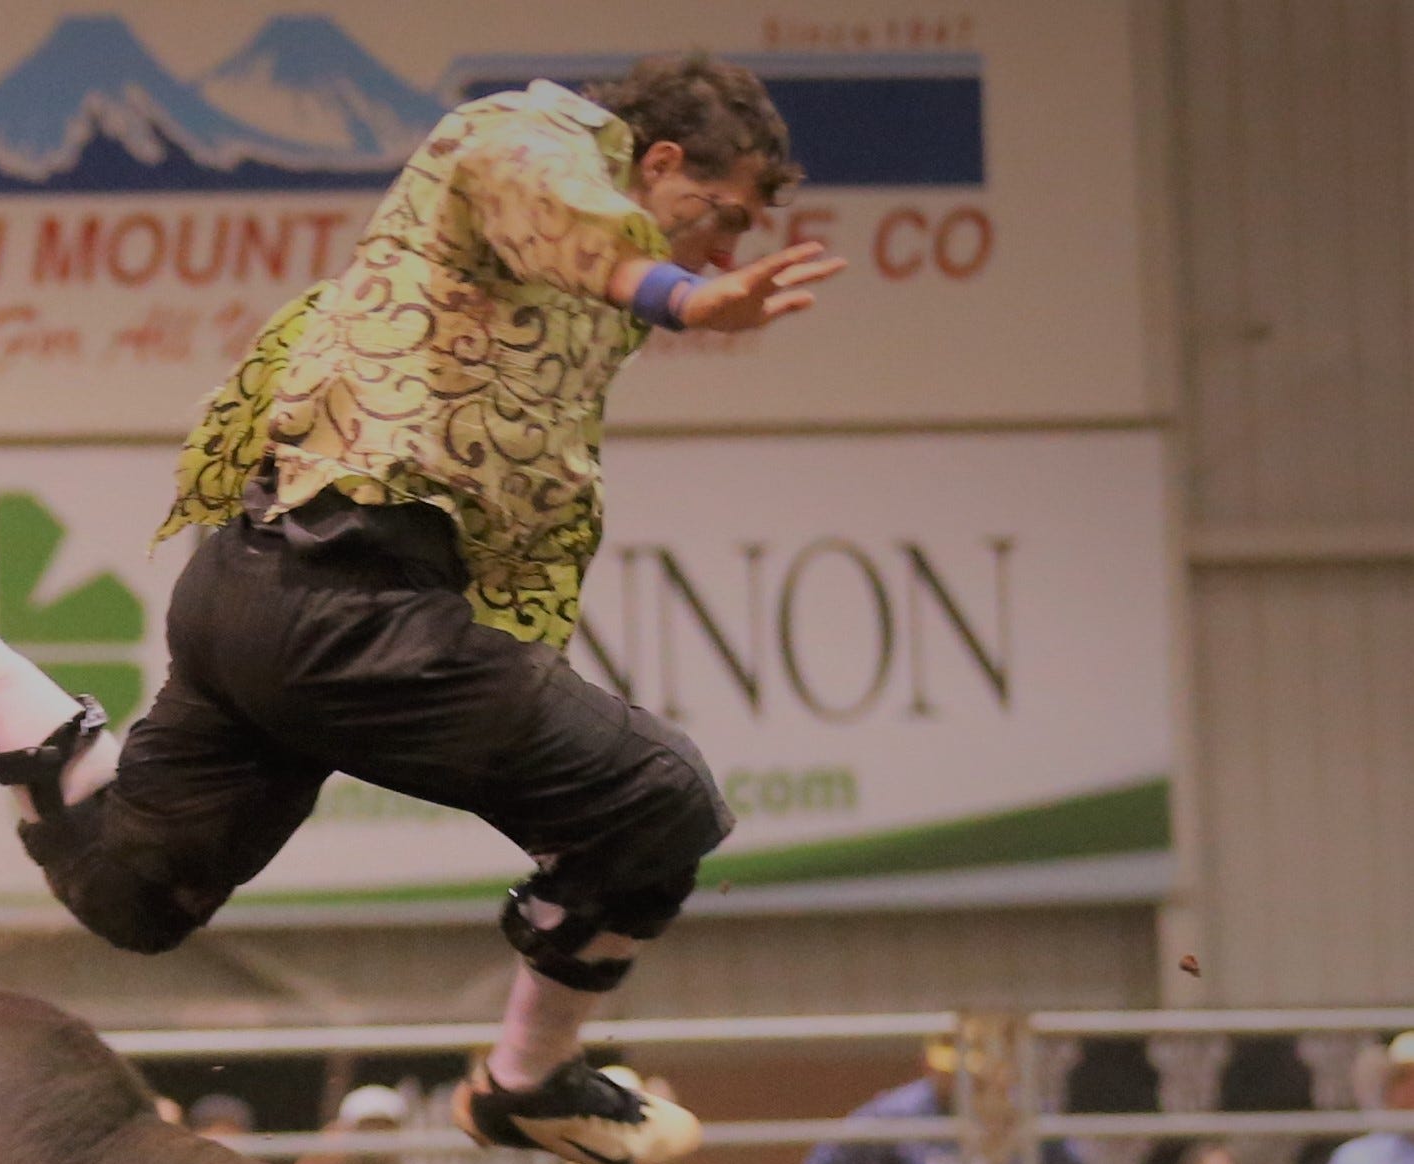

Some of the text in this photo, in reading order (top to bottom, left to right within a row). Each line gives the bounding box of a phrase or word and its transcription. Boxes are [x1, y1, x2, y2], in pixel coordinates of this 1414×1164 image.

[32, 211, 347, 286] MOUNT
[872, 207, 994, 281] CO
[580, 536, 1016, 724] NNON
